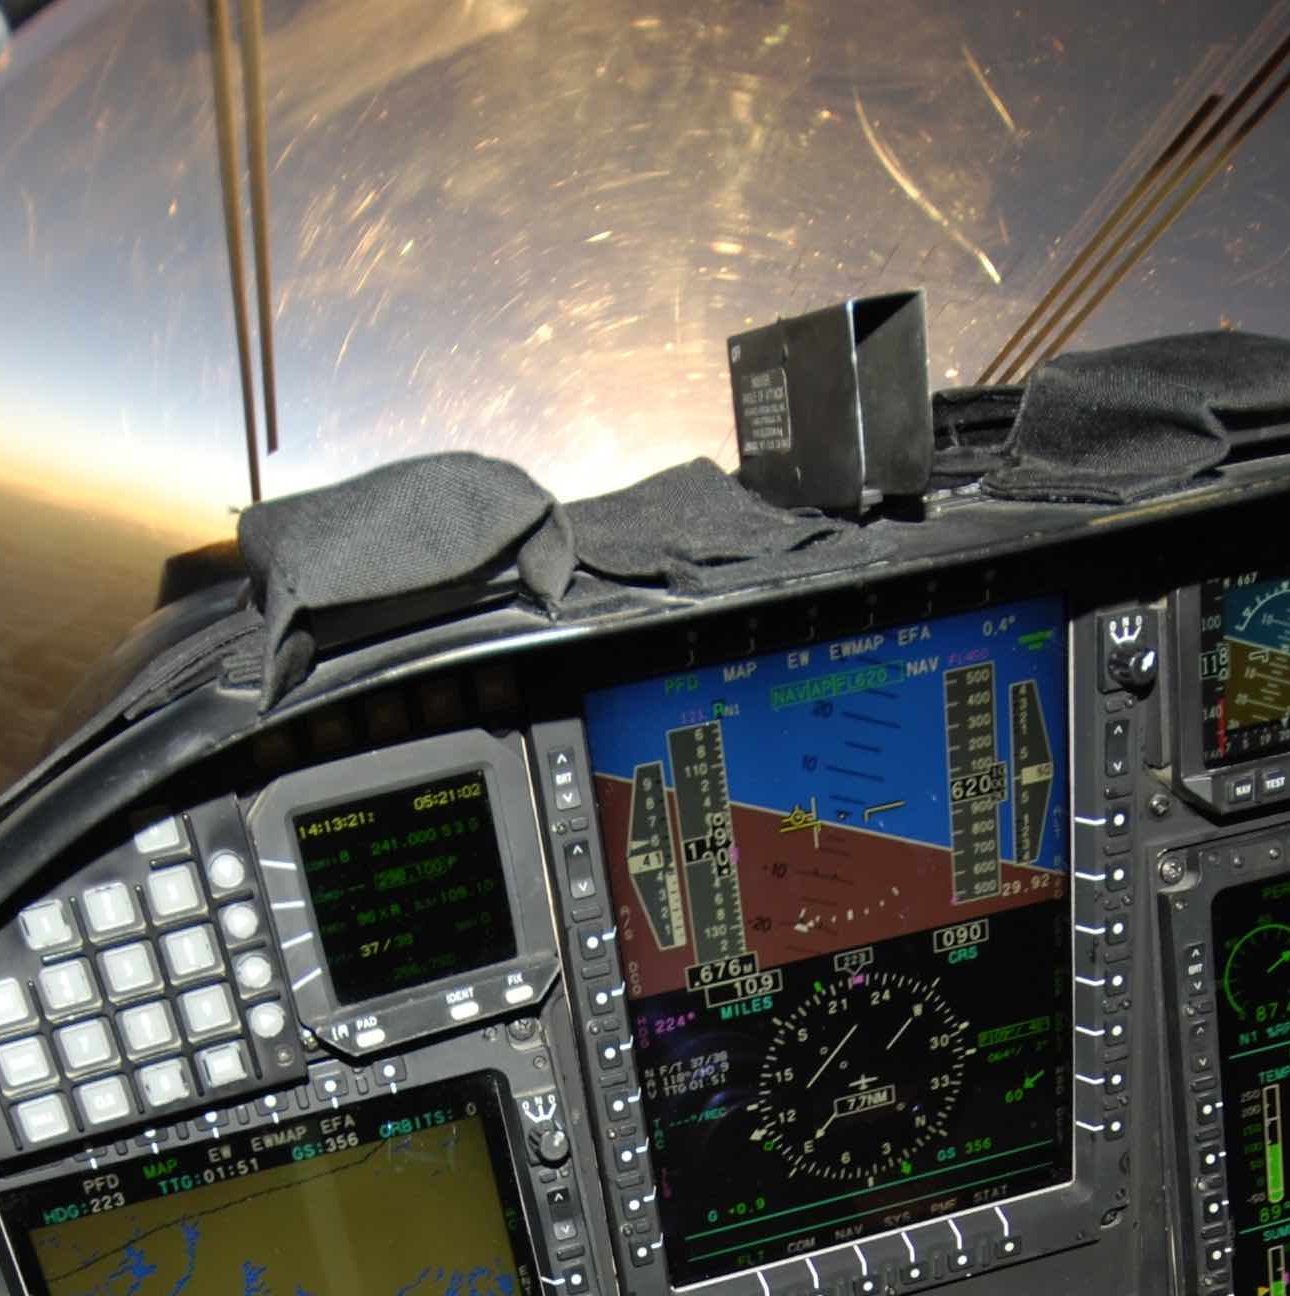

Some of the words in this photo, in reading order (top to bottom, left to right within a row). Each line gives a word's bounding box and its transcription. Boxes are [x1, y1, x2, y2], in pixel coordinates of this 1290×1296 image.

[664, 675, 699, 695] PFD
[723, 661, 757, 683] MAP
[788, 650, 810, 669] EW
[829, 633, 885, 660] EWMAP
[897, 624, 933, 648] EFA
[905, 656, 940, 678] NAV
[965, 669, 990, 683] 500
[967, 692, 991, 706] 400
[968, 714, 992, 729] 300
[968, 736, 993, 751] 200
[685, 764, 708, 777] 110
[1265, 775, 1285, 790] TEST
[412, 782, 483, 812] 05:21:02
[973, 841, 996, 856] 700
[1002, 873, 1050, 897] 29.92
[941, 926, 982, 948] 090
[948, 947, 979, 965] CRS
[871, 988, 891, 1006] 24
[356, 1015, 378, 1031] PAD
[445, 986, 475, 1004] IDENT
[721, 995, 774, 1021] MILES
[929, 1034, 950, 1051] 30
[775, 1068, 795, 1084] 15
[930, 1073, 951, 1091] 33
[777, 1110, 798, 1125] 12
[964, 1135, 994, 1156] 356
[83, 1173, 120, 1196] PFD
[143, 1159, 178, 1180] MAP
[208, 1144, 233, 1163] EW
[251, 1126, 308, 1153] EWMAP
[320, 1114, 356, 1135] EFA
[43, 1192, 127, 1225] HDG:223
[157, 1158, 259, 1197] TTG:01:51
[291, 1132, 359, 1162] GS:356
[378, 1108, 454, 1140] ORBITS:
[787, 1236, 817, 1254] COM
[834, 1222, 865, 1240] NAV
[972, 1184, 1010, 1202] STAT
